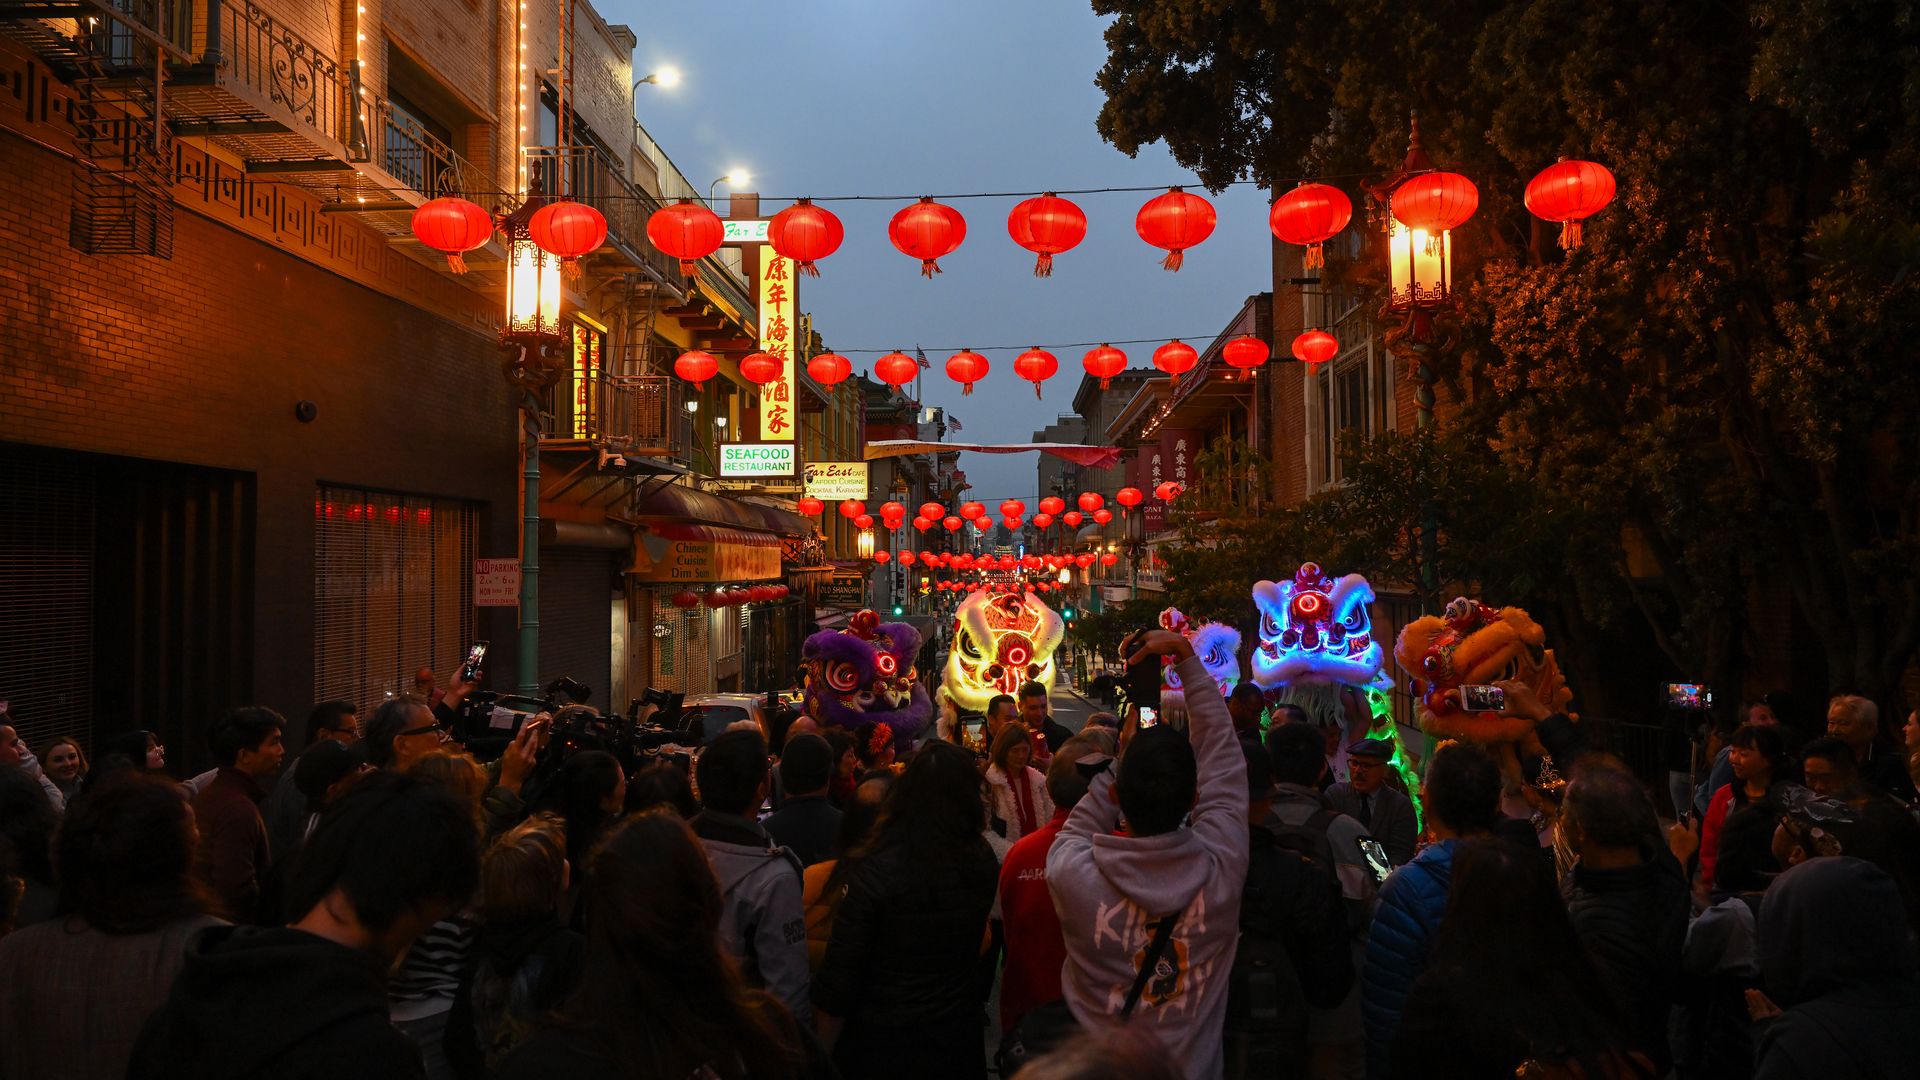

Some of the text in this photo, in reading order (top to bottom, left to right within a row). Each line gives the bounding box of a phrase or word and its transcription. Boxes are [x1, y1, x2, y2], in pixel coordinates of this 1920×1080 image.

[725, 223, 748, 236] Far
[725, 448, 790, 460] SEAFOOD
[724, 461, 792, 471] RESTAURANT
[804, 464, 825, 477] Far
[826, 464, 853, 477] East
[675, 542, 708, 553] Chinese
[676, 554, 707, 565] Cuisine
[476, 560, 518, 574] NO PARKING
[671, 567, 710, 578] Dim Sum
[480, 587, 491, 596] MON
[504, 587, 514, 595] FRI
[832, 585, 861, 594] SHANGHAI
[1018, 867, 1045, 881] AAR
